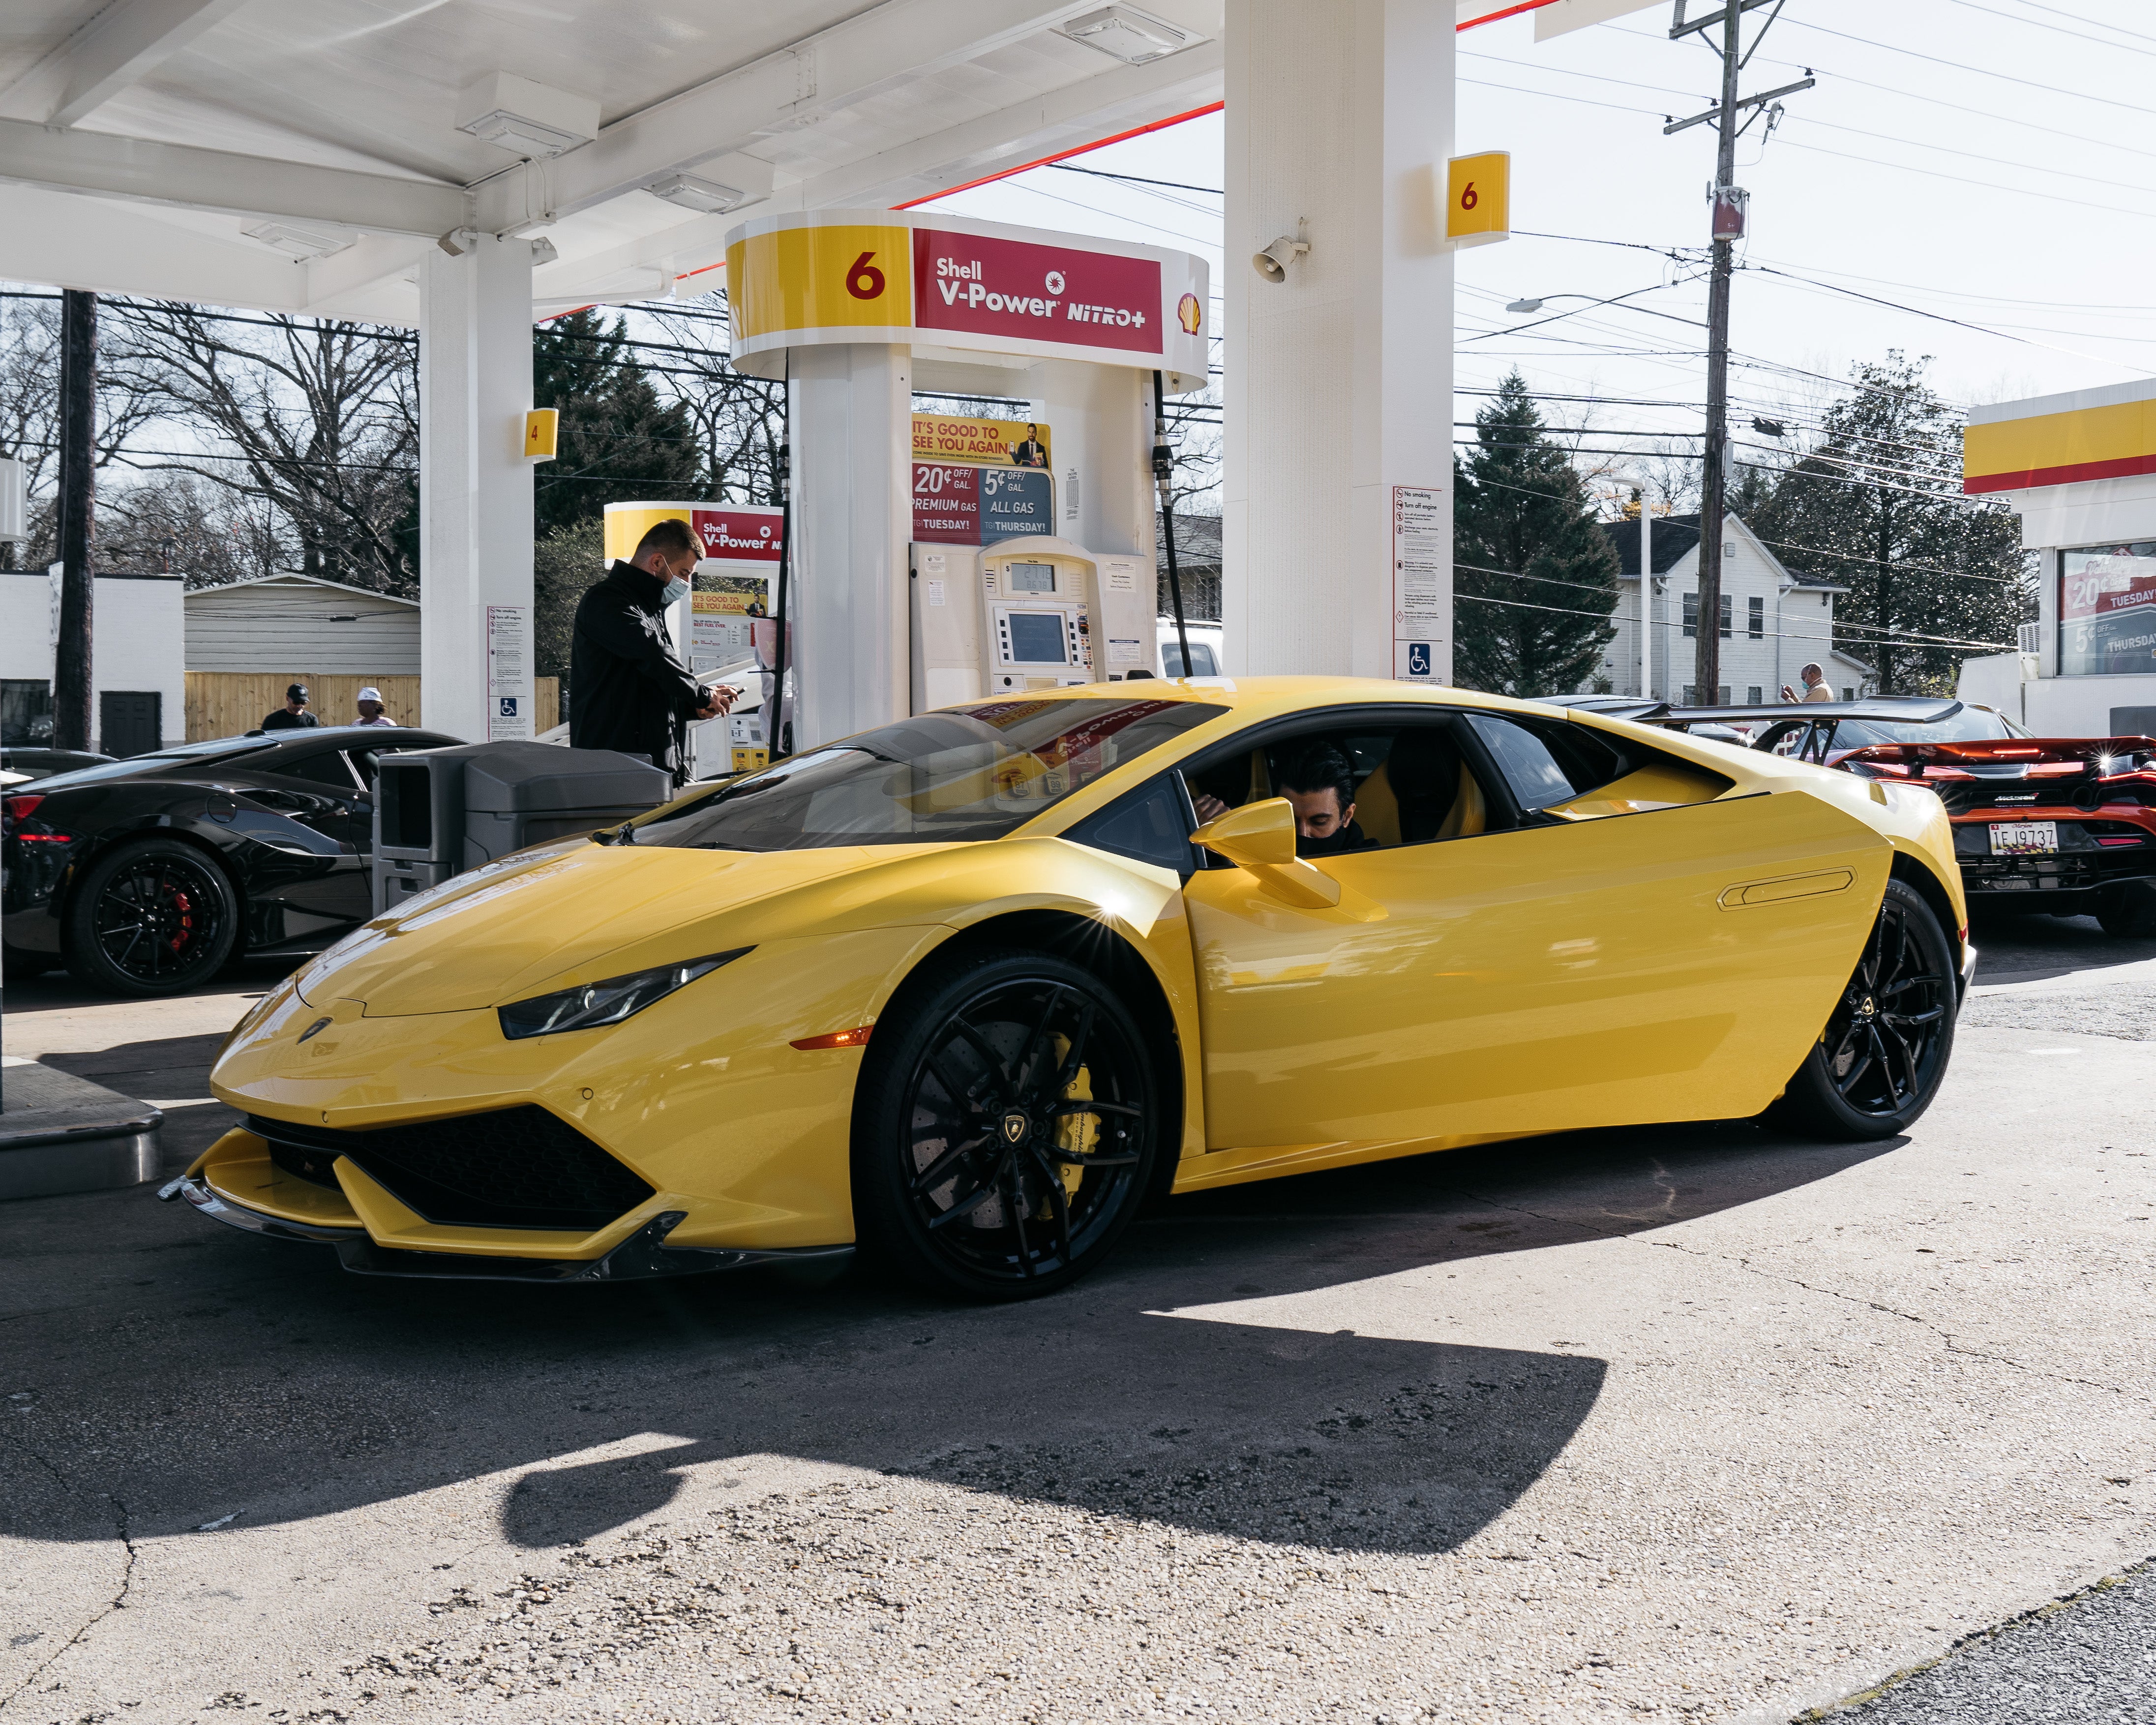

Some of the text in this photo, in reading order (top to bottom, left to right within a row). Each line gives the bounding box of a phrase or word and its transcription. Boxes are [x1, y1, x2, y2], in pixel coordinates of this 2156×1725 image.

[1462, 182, 1478, 211] 6
[846, 251, 885, 300] 6
[936, 257, 982, 280] Shell
[936, 279, 1057, 318] V-Power
[532, 425, 538, 441] 4
[913, 421, 999, 439] IT'S GOOD TO
[913, 435, 933, 449] SEE
[937, 437, 964, 451] YOU
[954, 469, 973, 479] OFF/
[1007, 471, 1026, 481] OFF/
[954, 480, 971, 489] GAL.
[1008, 483, 1024, 492] GAL.
[961, 502, 977, 512] GAS
[990, 501, 1034, 514] ALL GAS
[703, 523, 727, 533] Shell
[923, 519, 970, 530] TUESDAY!
[995, 521, 1046, 532] THURSDAY!
[703, 534, 766, 549] V-Power
[1994, 829, 2053, 850] 1EJ9737
